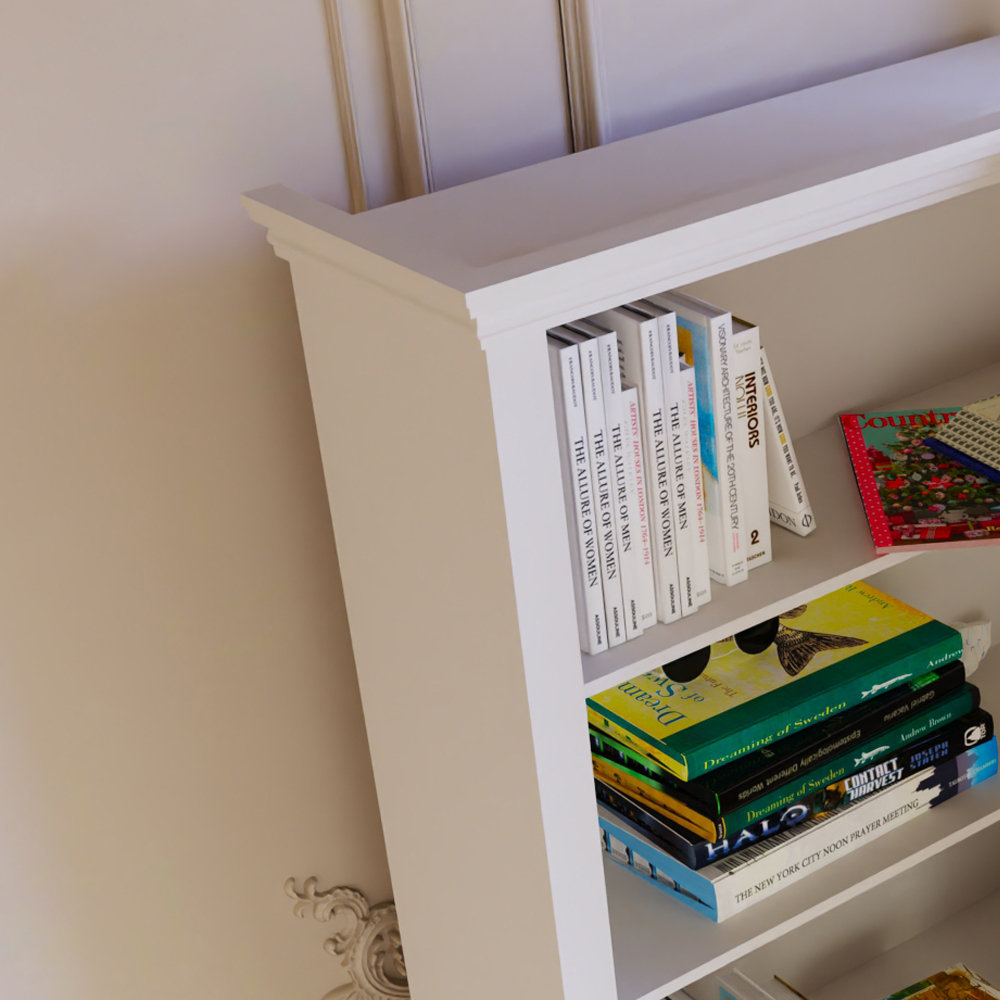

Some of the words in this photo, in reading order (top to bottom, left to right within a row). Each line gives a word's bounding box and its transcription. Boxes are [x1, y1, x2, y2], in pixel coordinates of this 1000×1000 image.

[652, 408, 664, 436] THE
[670, 403, 681, 430] THE
[745, 371, 760, 449] INTERIORS
[842, 410, 956, 431] Countr
[573, 437, 586, 465] THE
[593, 430, 606, 457] THE
[611, 424, 623, 451] THE
[655, 436, 668, 487] ALLURE
[672, 429, 685, 481] ALLURE
[727, 442, 735, 462] THE
[576, 465, 592, 517] ALLURE
[596, 458, 611, 509] ALLURE
[614, 451, 628, 504] ALLURE
[676, 482, 686, 500] OF
[659, 488, 670, 506] OF
[730, 484, 739, 531] CENTURY
[582, 517, 594, 536] OF
[602, 510, 613, 528] OF
[619, 504, 629, 522] OF
[678, 502, 688, 528] MEN
[621, 524, 632, 552] MEN
[661, 509, 674, 556] WOMEN
[750, 529, 760, 545] 2
[584, 538, 599, 586] WOMEN
[604, 531, 617, 578] WOMEN
[680, 692, 705, 704] of
[704, 734, 773, 770] Dreaming
[776, 723, 792, 737] of
[794, 702, 847, 730] Sweden
[900, 726, 927, 743] Andrew
[928, 712, 952, 728] Brown
[766, 762, 799, 786] Different
[844, 757, 899, 791] CONTACT
[847, 768, 904, 800] HARVEST
[738, 782, 764, 800] Worlds
[746, 792, 794, 822] Dreaming
[796, 786, 806, 797] of
[808, 766, 845, 788] Sweden
[705, 804, 810, 861] HALO
[734, 888, 754, 903] THE
[754, 874, 775, 892] NEW
[776, 864, 801, 882] YORK
[801, 852, 822, 868] CITY
[822, 836, 850, 858] NOON
[850, 819, 882, 840] PRAYER
[882, 798, 920, 824] MEETING
